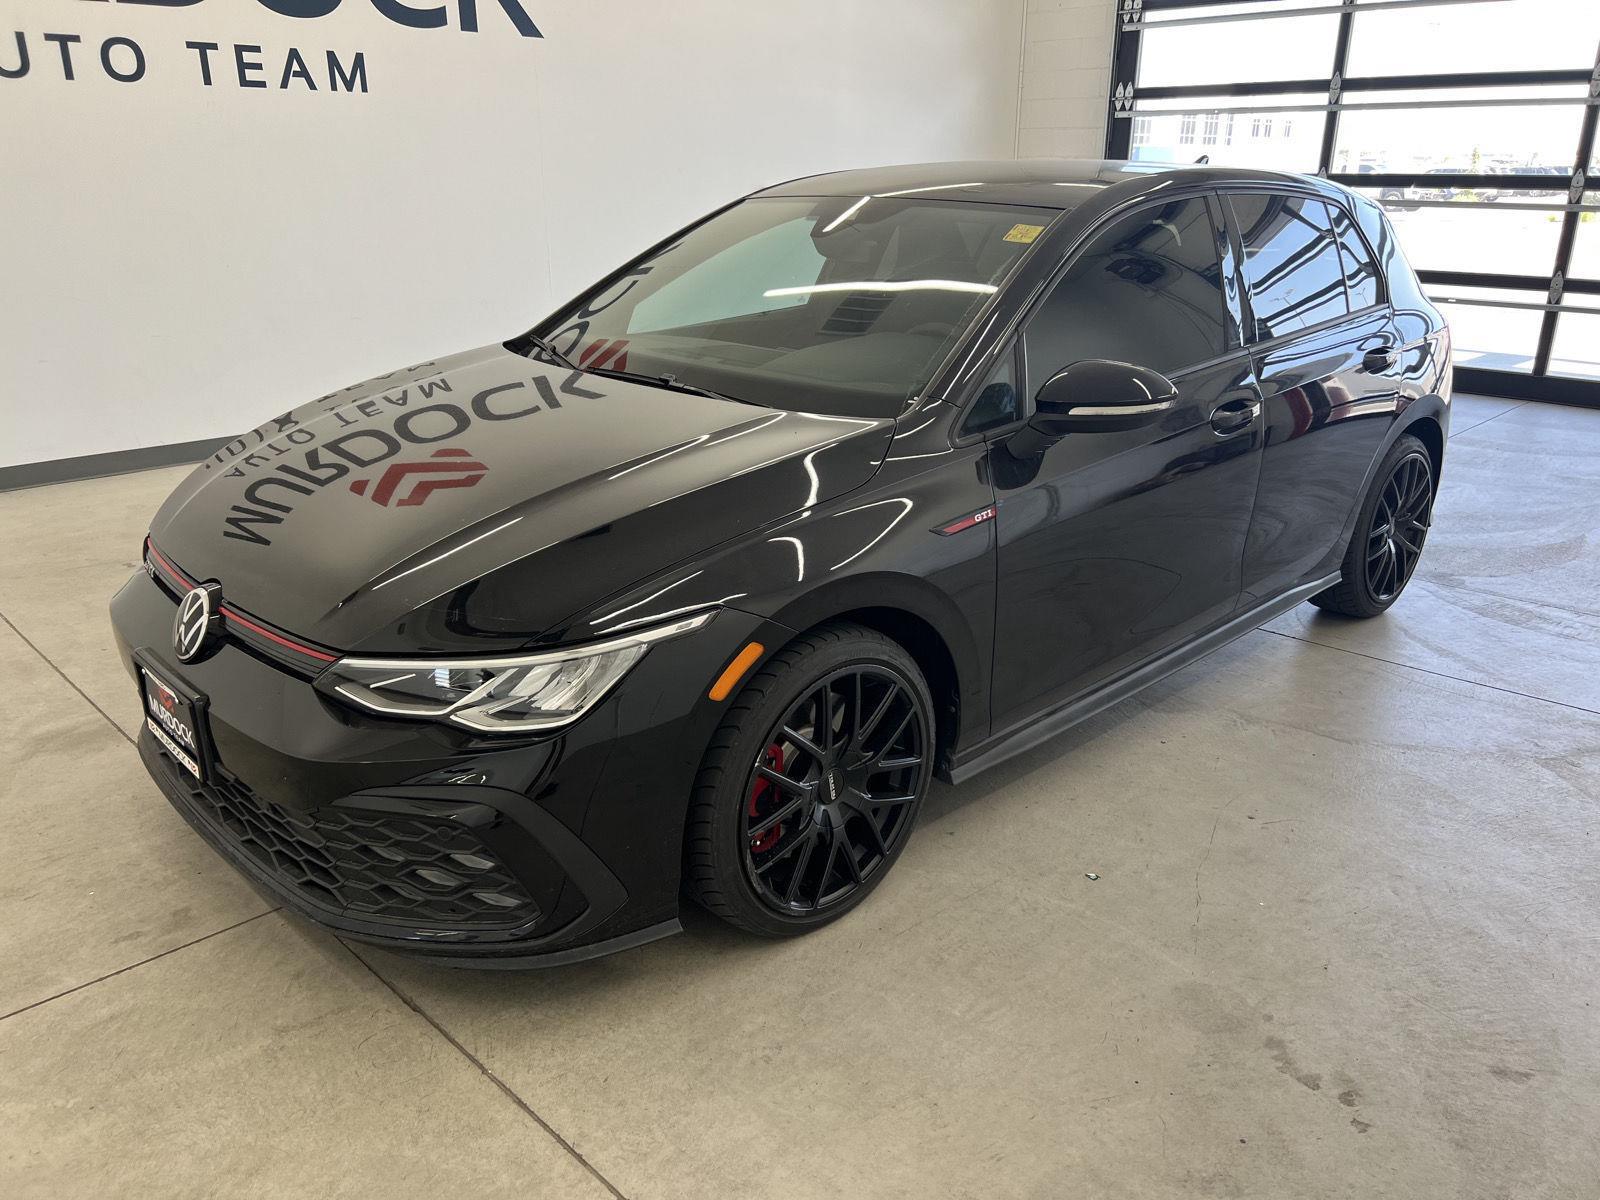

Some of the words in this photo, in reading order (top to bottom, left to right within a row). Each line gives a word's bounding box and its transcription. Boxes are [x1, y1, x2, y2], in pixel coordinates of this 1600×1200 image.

[0, 31, 147, 83] UTO
[185, 40, 369, 94] TEAM
[974, 509, 993, 522] GTI
[148, 694, 195, 749] MURDOCK
